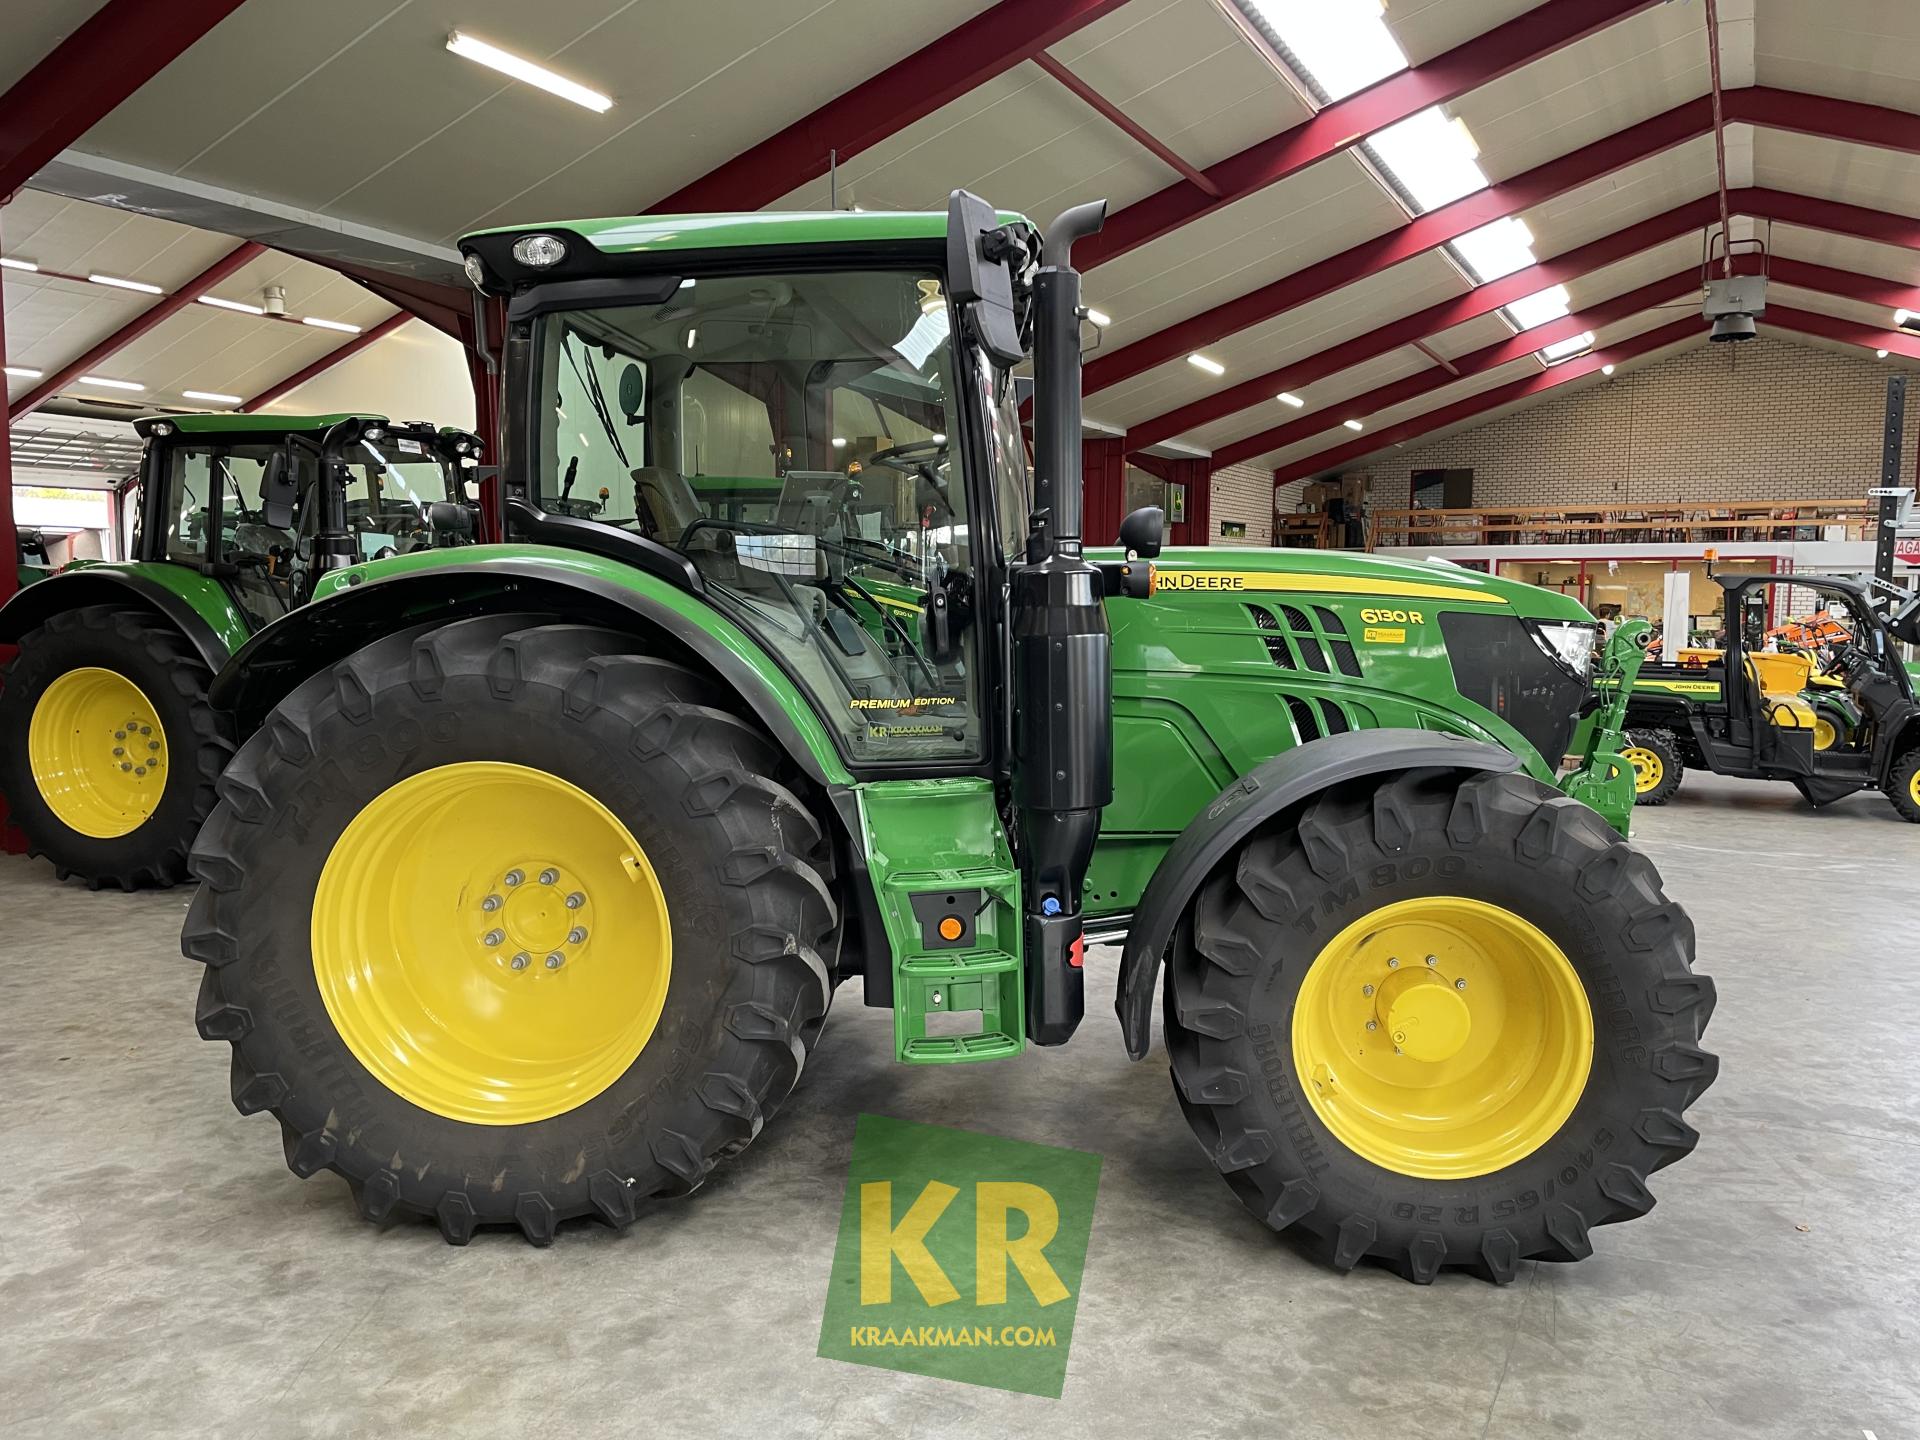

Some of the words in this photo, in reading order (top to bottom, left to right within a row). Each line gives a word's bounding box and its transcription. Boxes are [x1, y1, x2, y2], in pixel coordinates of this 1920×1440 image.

[1157, 576, 1177, 588] HN
[1181, 574, 1244, 589] DEERE
[1360, 608, 1408, 624] 6130
[1408, 611, 1425, 624] R
[849, 698, 911, 709] PREMIUM
[914, 697, 956, 706] EDITION
[869, 726, 888, 738] KR
[890, 725, 943, 734] KRAAKMAN
[1291, 877, 1361, 936] TM
[1367, 855, 1466, 889] 800
[1249, 1022, 1331, 1181] TRELLEBORG
[1492, 1126, 1617, 1219] 540/65
[1391, 1202, 1445, 1224] 28
[1453, 1204, 1480, 1226] R
